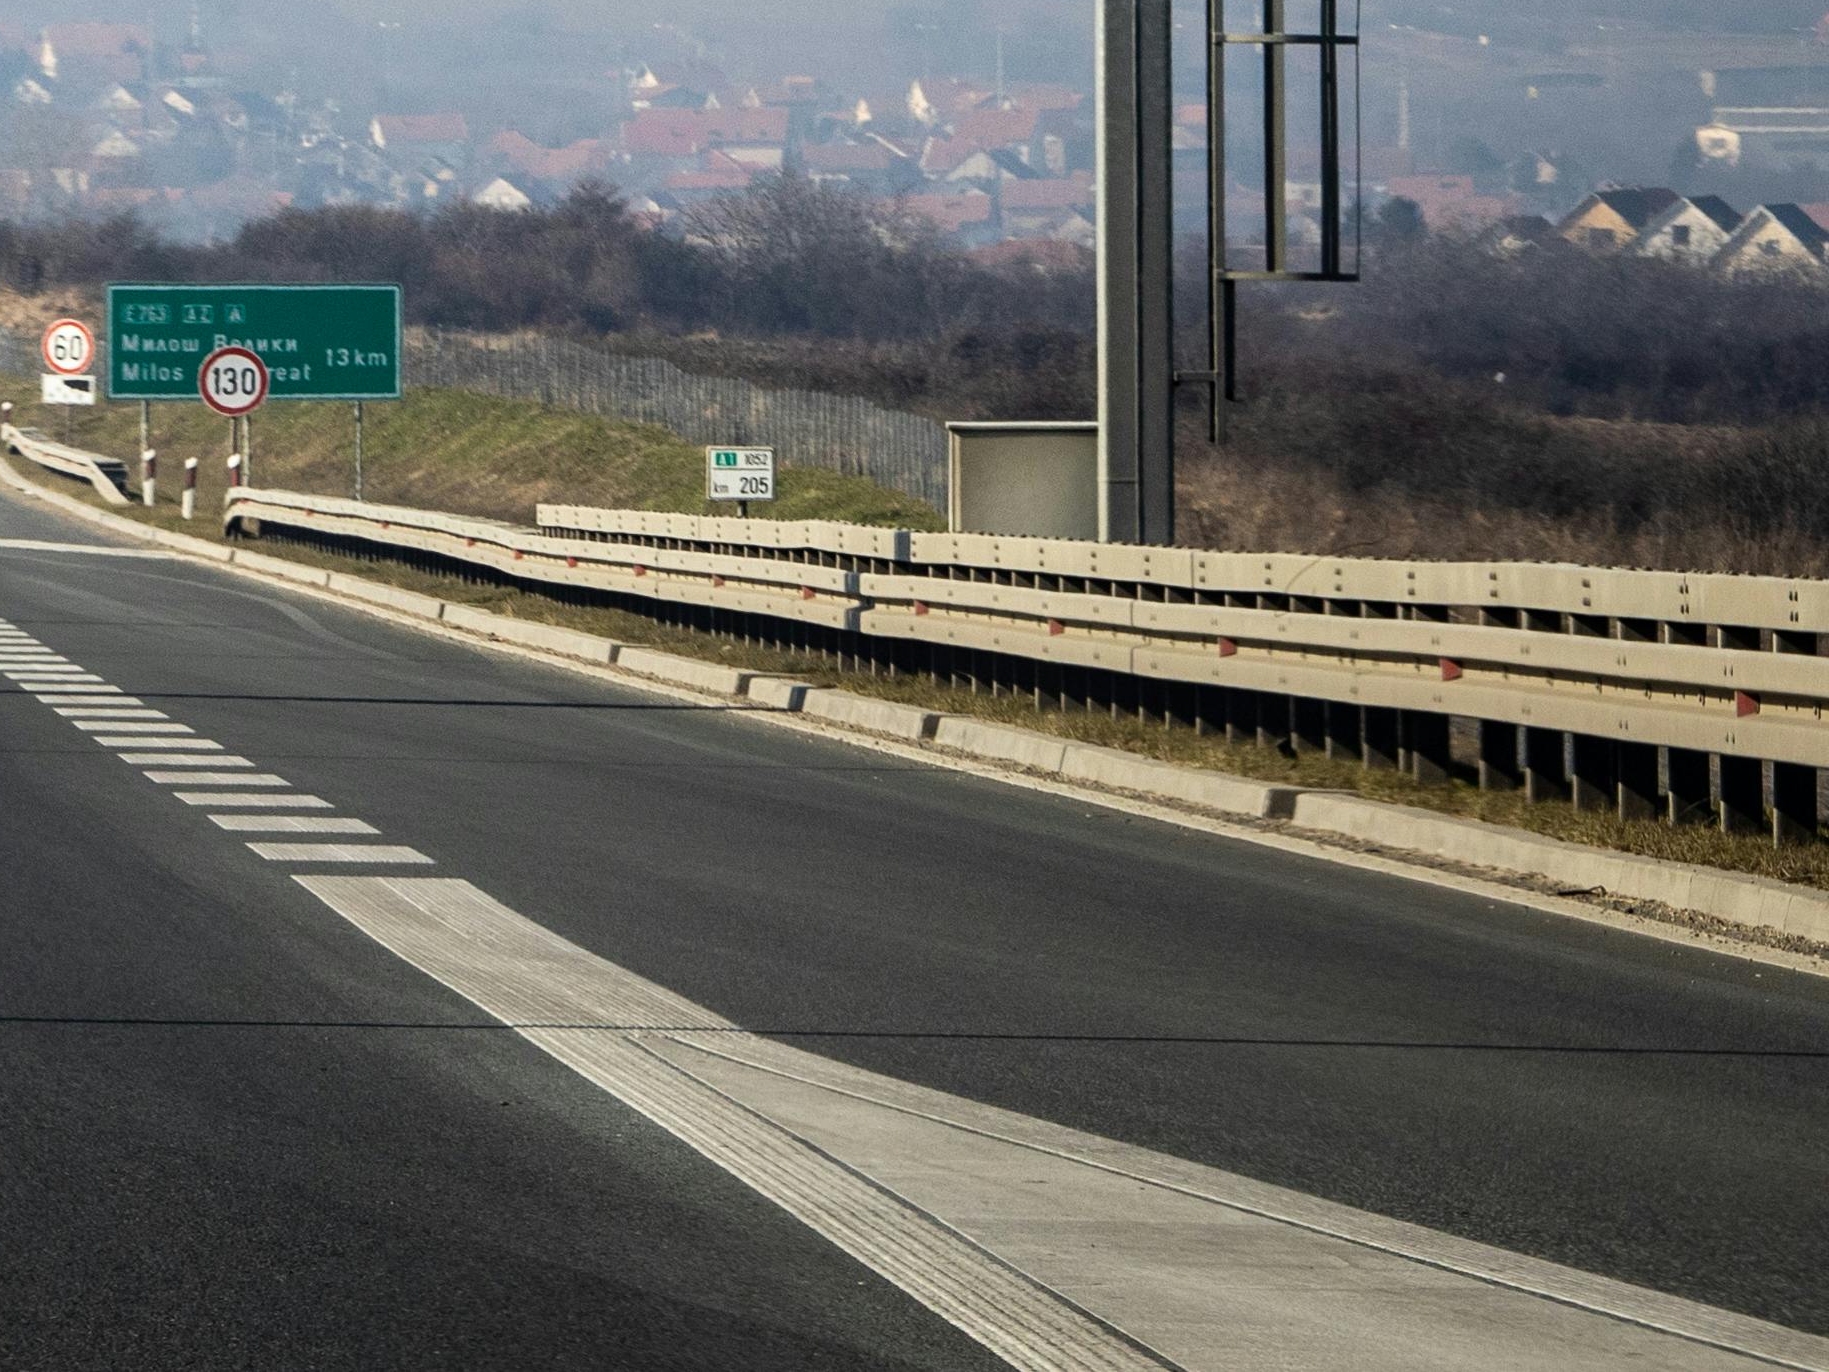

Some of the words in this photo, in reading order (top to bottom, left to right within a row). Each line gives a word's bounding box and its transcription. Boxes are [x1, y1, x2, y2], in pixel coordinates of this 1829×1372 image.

[55, 334, 82, 361] 60
[211, 366, 258, 397] 130
[739, 476, 769, 495] 205
